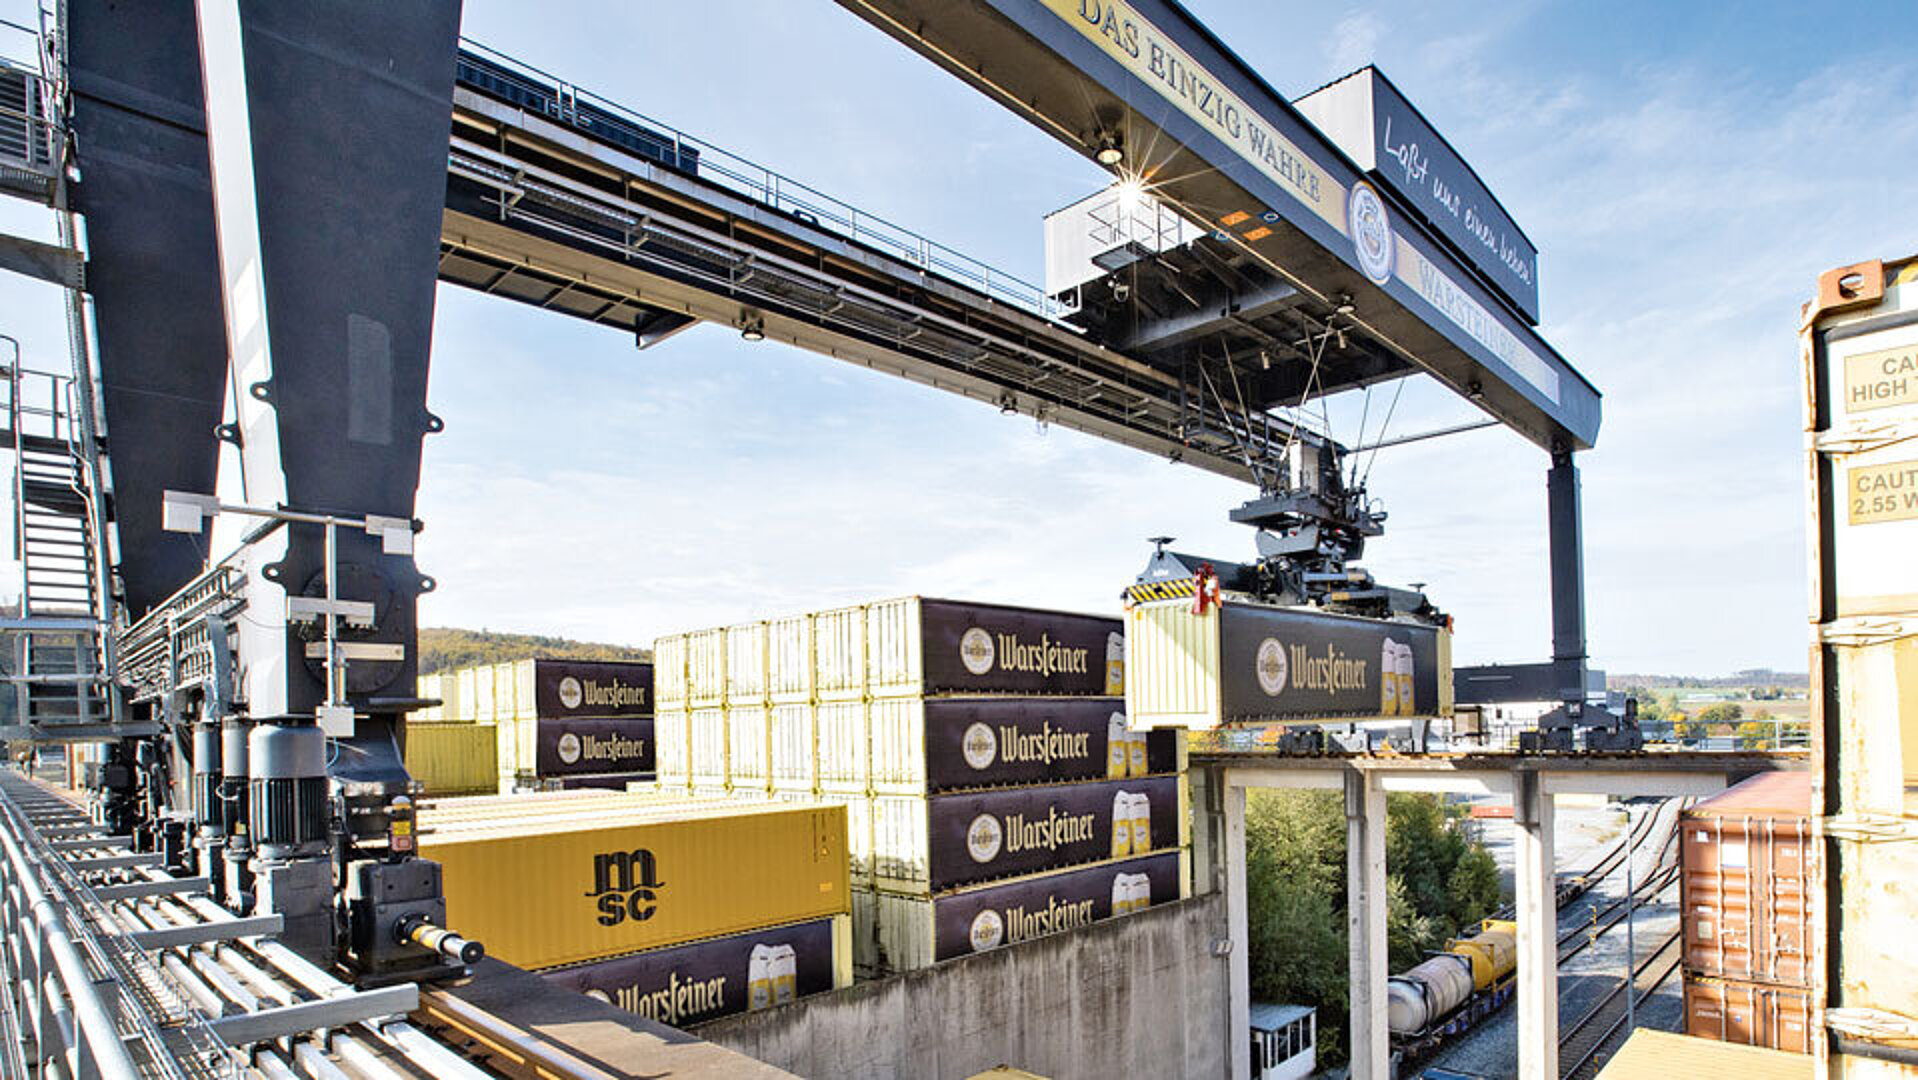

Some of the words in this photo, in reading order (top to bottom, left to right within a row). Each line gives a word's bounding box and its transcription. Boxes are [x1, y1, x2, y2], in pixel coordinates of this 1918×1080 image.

[1147, 36, 1241, 139] EINZIG
[1246, 117, 1321, 203] WAHRE
[1433, 177, 1461, 217] uns
[1852, 378, 1907, 403] HIGH
[1854, 495, 1897, 515] 2.55
[998, 633, 1088, 677] Warsteiner
[1290, 642, 1367, 695] Warsteiner
[583, 677, 645, 709] Warsteiner
[582, 732, 644, 762] Warsteiner
[1000, 720, 1089, 765] Warsteiner
[1005, 805, 1095, 851] Warsteiner
[1006, 895, 1094, 945] Warsteiner
